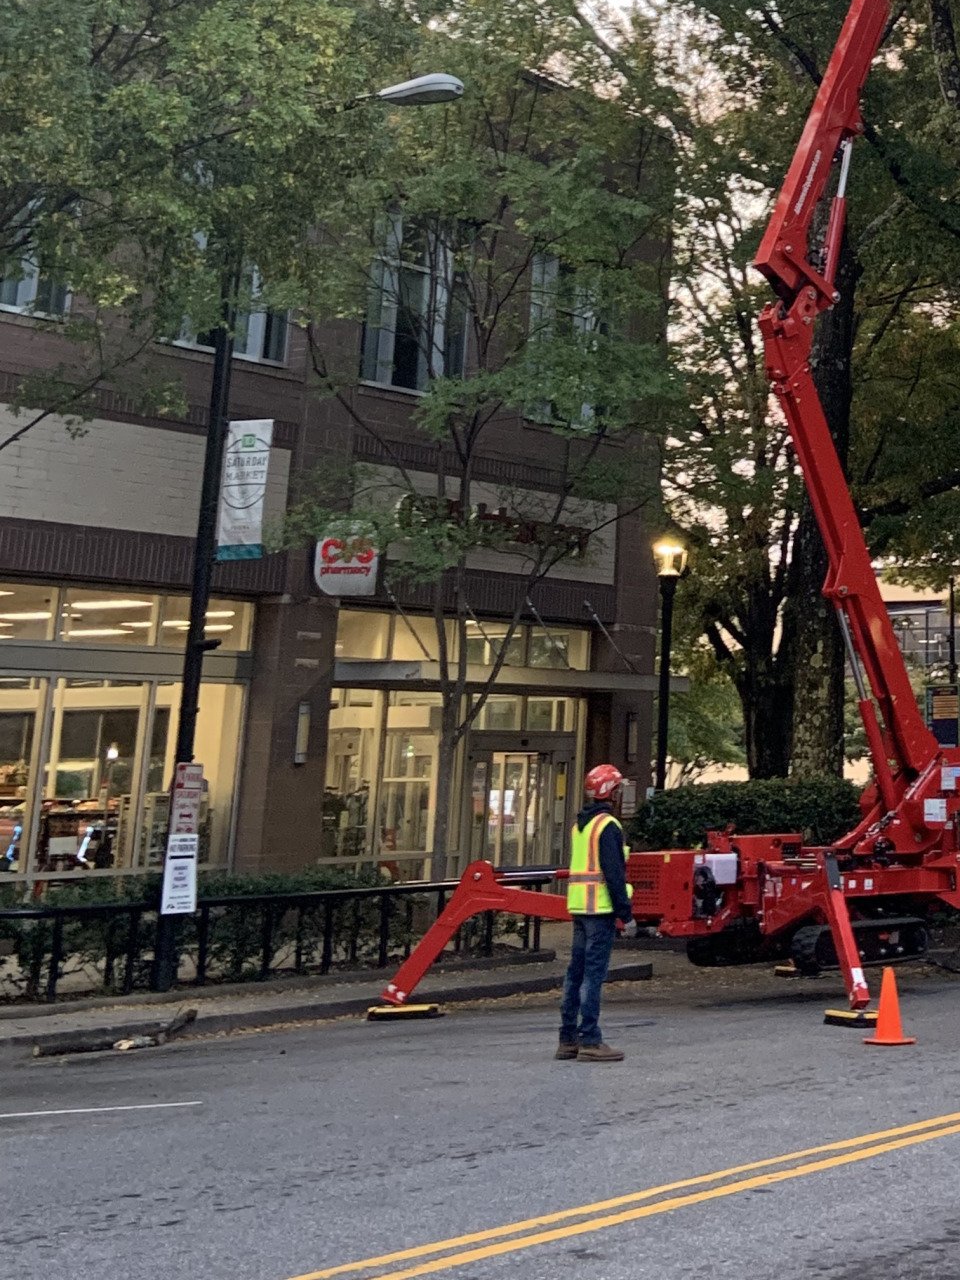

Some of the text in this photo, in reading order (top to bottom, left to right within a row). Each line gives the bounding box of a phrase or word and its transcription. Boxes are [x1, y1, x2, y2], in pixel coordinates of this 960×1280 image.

[226, 456, 267, 468] SATURDAY
[225, 470, 266, 481] MARKET
[320, 566, 372, 577] pharmacy
